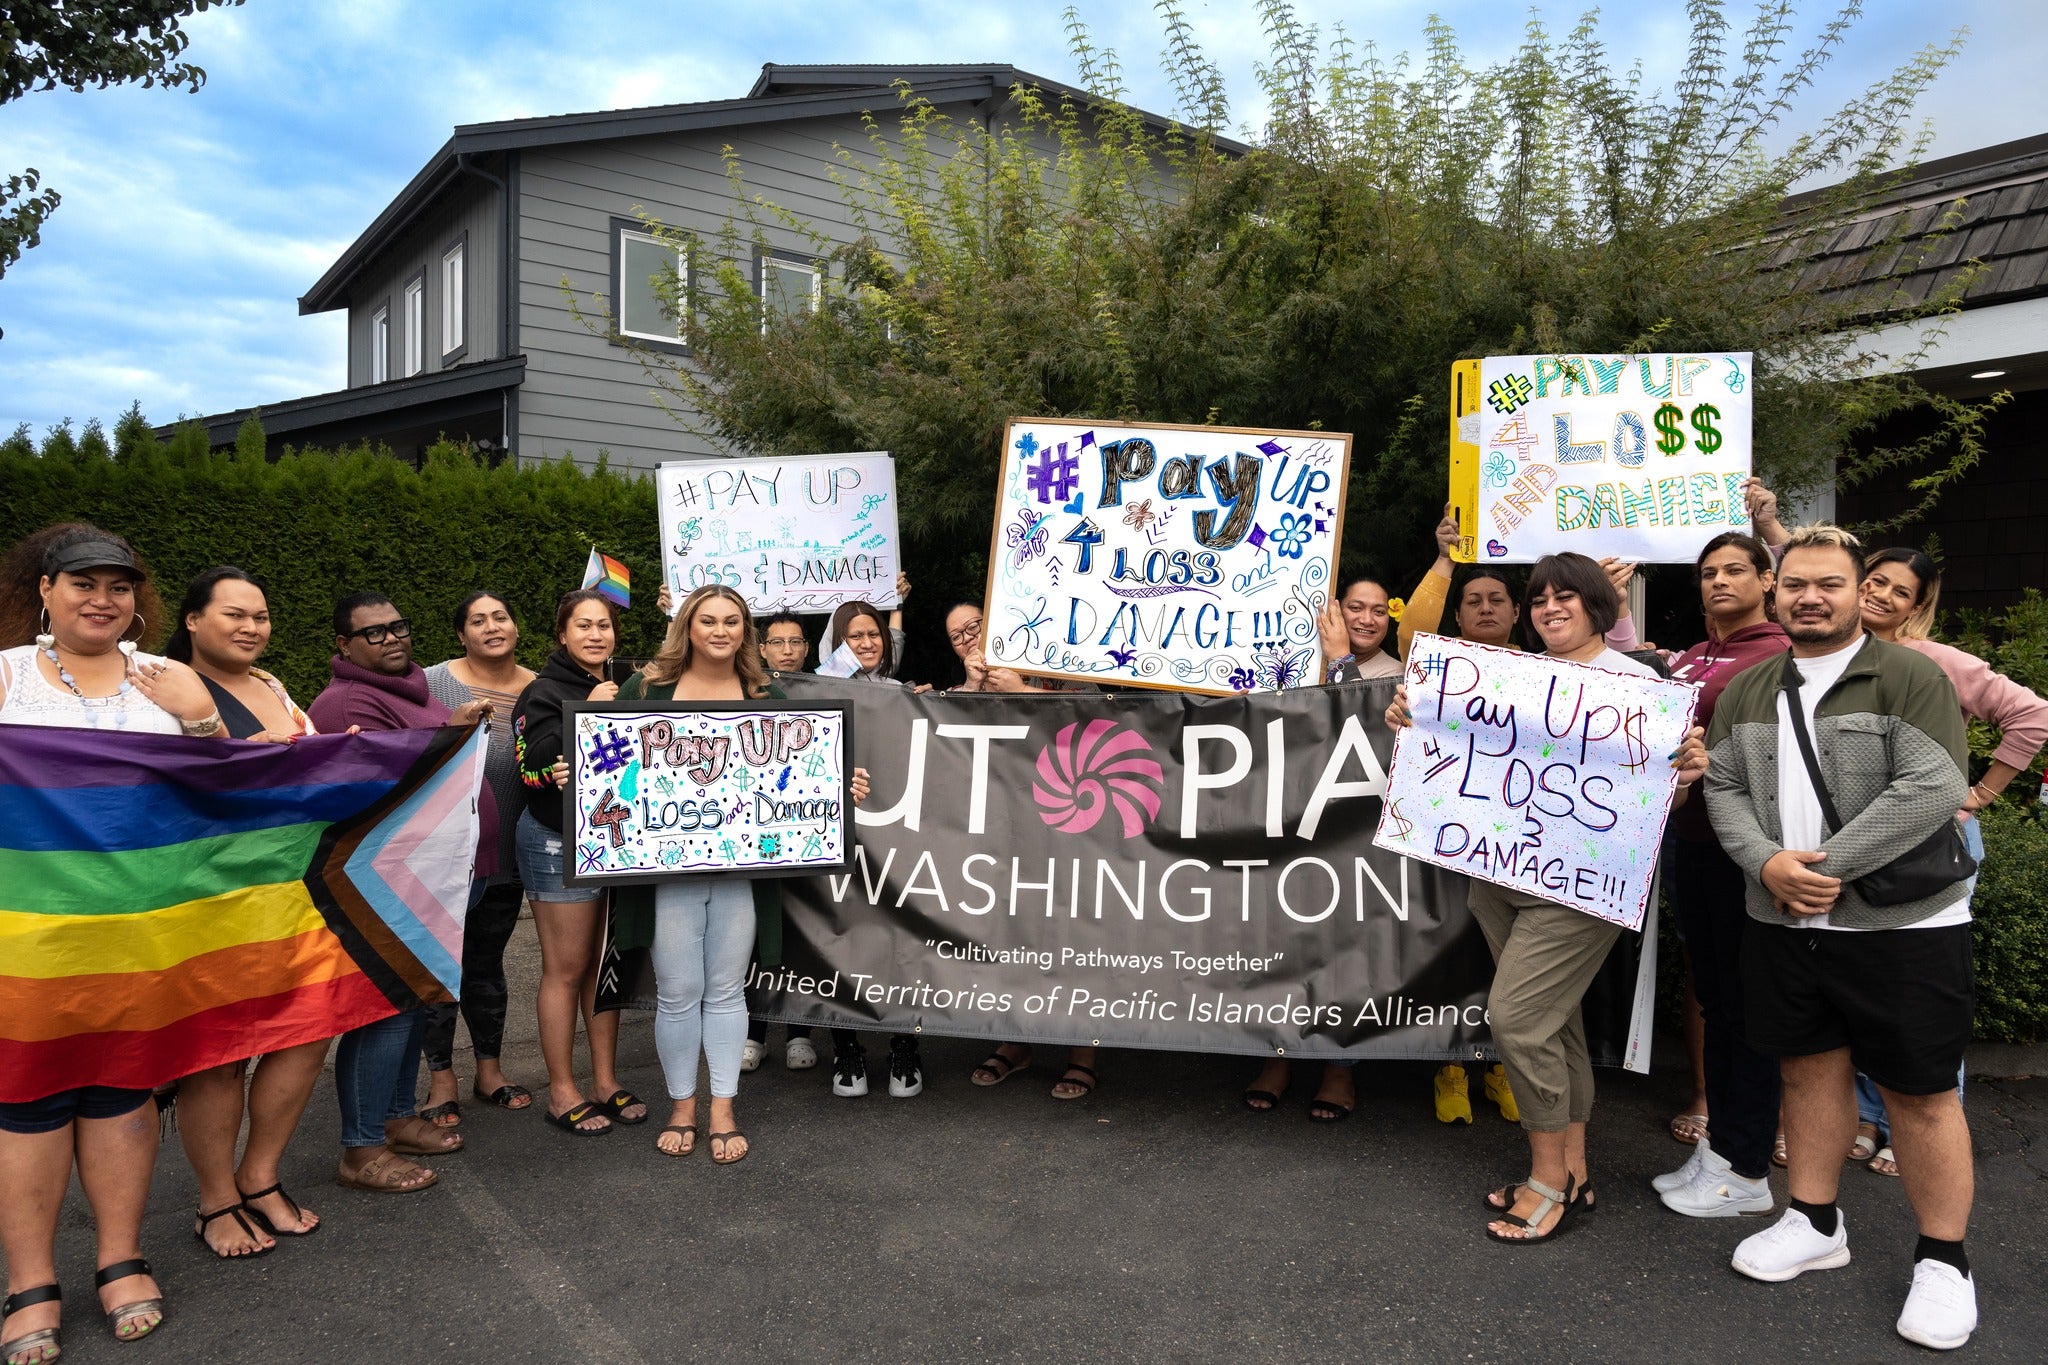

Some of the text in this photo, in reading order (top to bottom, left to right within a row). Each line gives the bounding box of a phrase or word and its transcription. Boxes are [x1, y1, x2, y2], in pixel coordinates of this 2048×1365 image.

[1637, 356, 1711, 399] UP
[1489, 411, 1539, 461] 4
[804, 467, 861, 505] UP
[1489, 463, 1559, 540] AND
[1555, 471, 1750, 532] DAMAGE
[670, 563, 742, 593] LOSS
[778, 554, 888, 587] DAMAGE
[1058, 516, 1105, 575] 4
[1232, 551, 1289, 594] and
[1423, 733, 1618, 832] 4 LOSS
[588, 788, 632, 849] 4
[725, 793, 752, 825] and
[753, 791, 841, 834] Damage
[829, 844, 1409, 923] WASHINGTON
[1061, 947, 1163, 970] Pathways
[850, 973, 1012, 1014] Territories
[1023, 986, 1062, 1014] of
[1067, 987, 1177, 1021] Pacific
[1187, 993, 1343, 1026] Islanders
